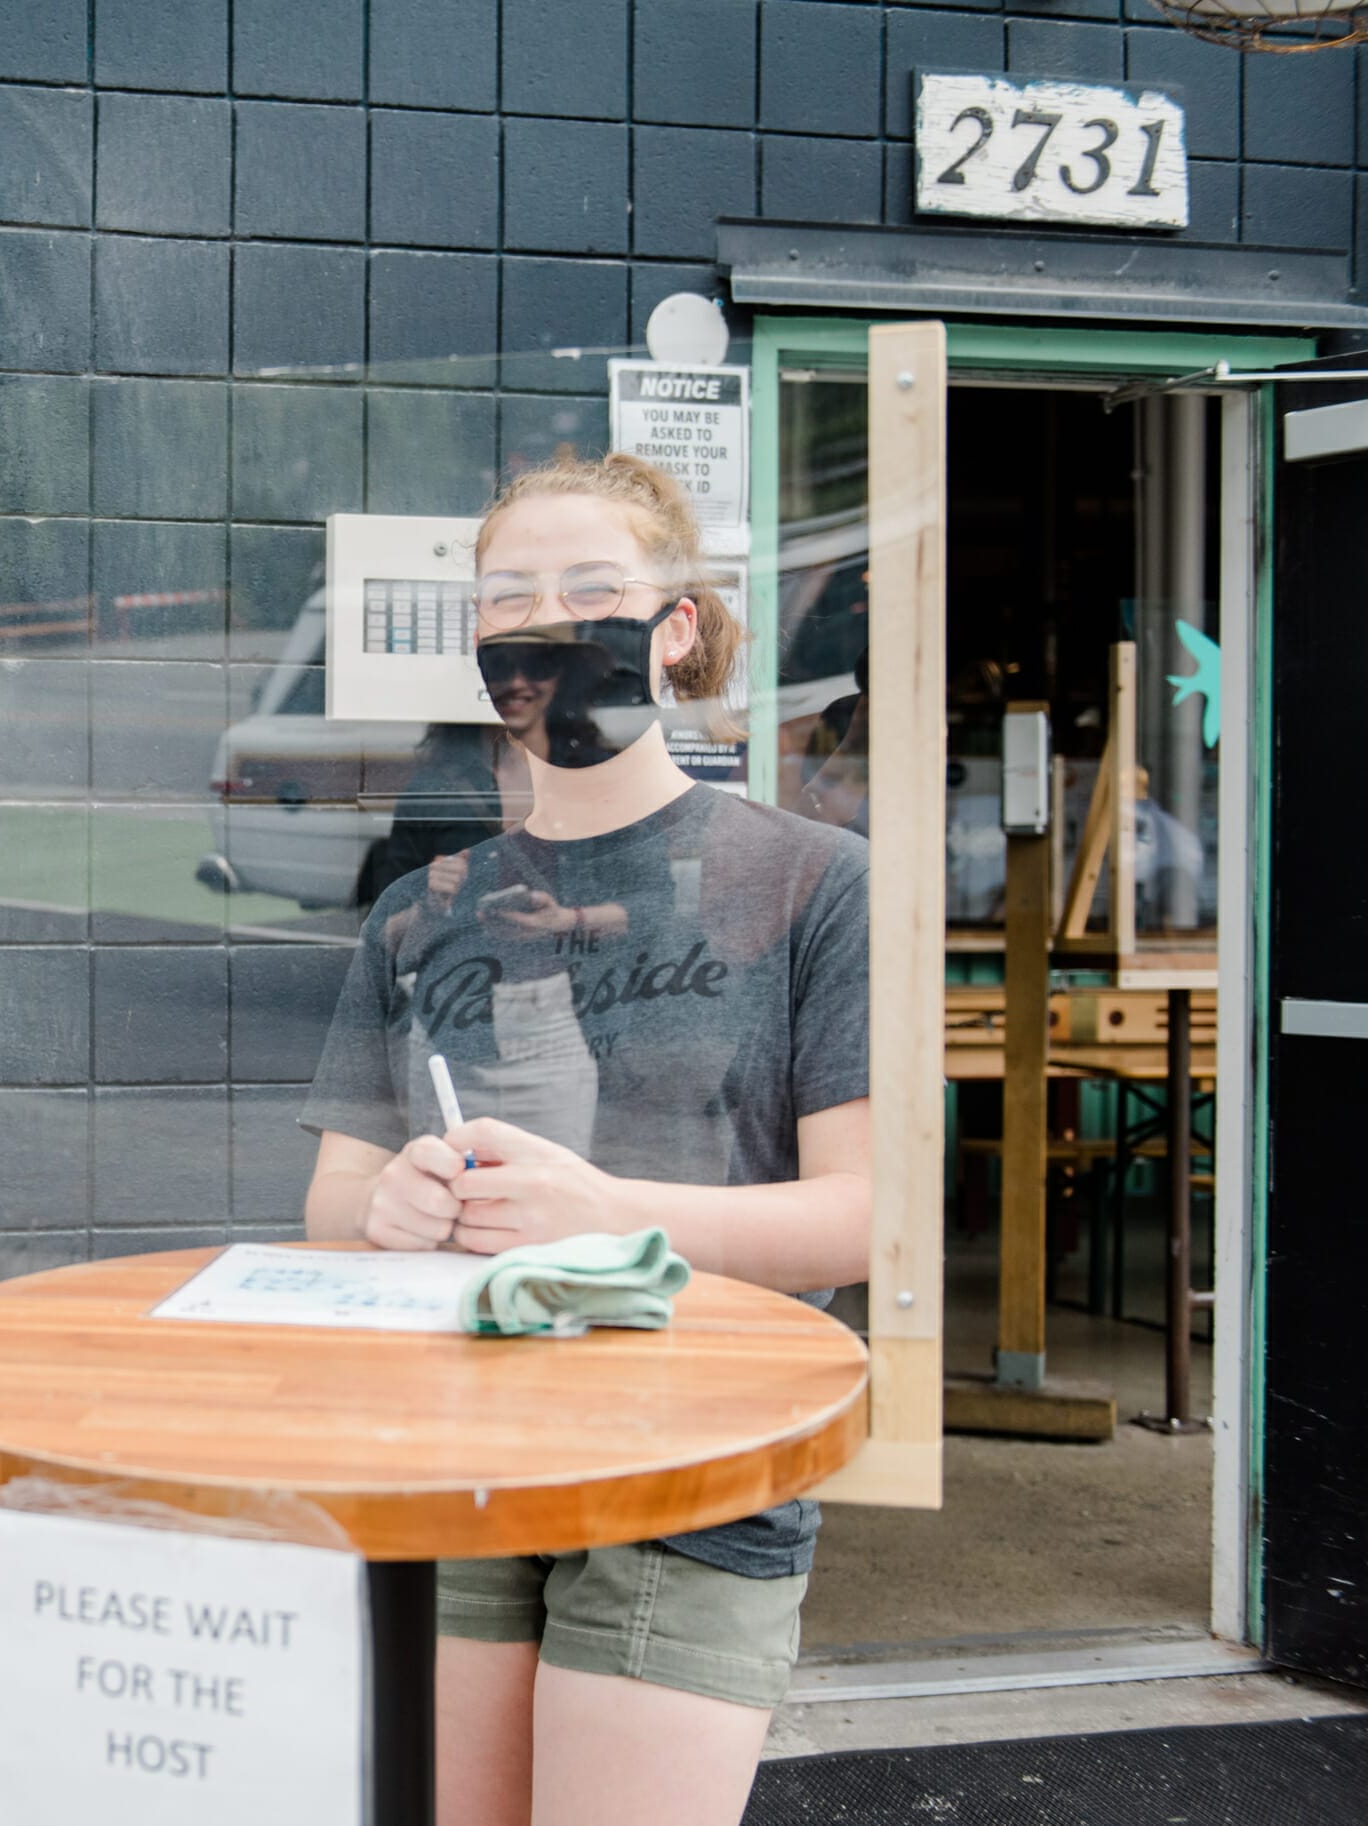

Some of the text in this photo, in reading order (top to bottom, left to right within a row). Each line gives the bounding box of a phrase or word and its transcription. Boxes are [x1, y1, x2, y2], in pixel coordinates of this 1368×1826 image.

[936, 105, 1166, 197] 2731
[640, 378, 721, 400] NOTICE
[643, 409, 721, 425] YOU MAY BE
[650, 426, 713, 442] ASKED TO
[634, 442, 728, 460] REMOVE YOUR
[695, 463, 711, 477] TO
[697, 481, 711, 494] ID
[554, 930, 600, 955] THE
[422, 940, 729, 1038] Paside
[34, 1579, 299, 1650] PLEASE WAIT
[76, 1656, 246, 1717] FOR THE
[106, 1730, 215, 1781] HOST
